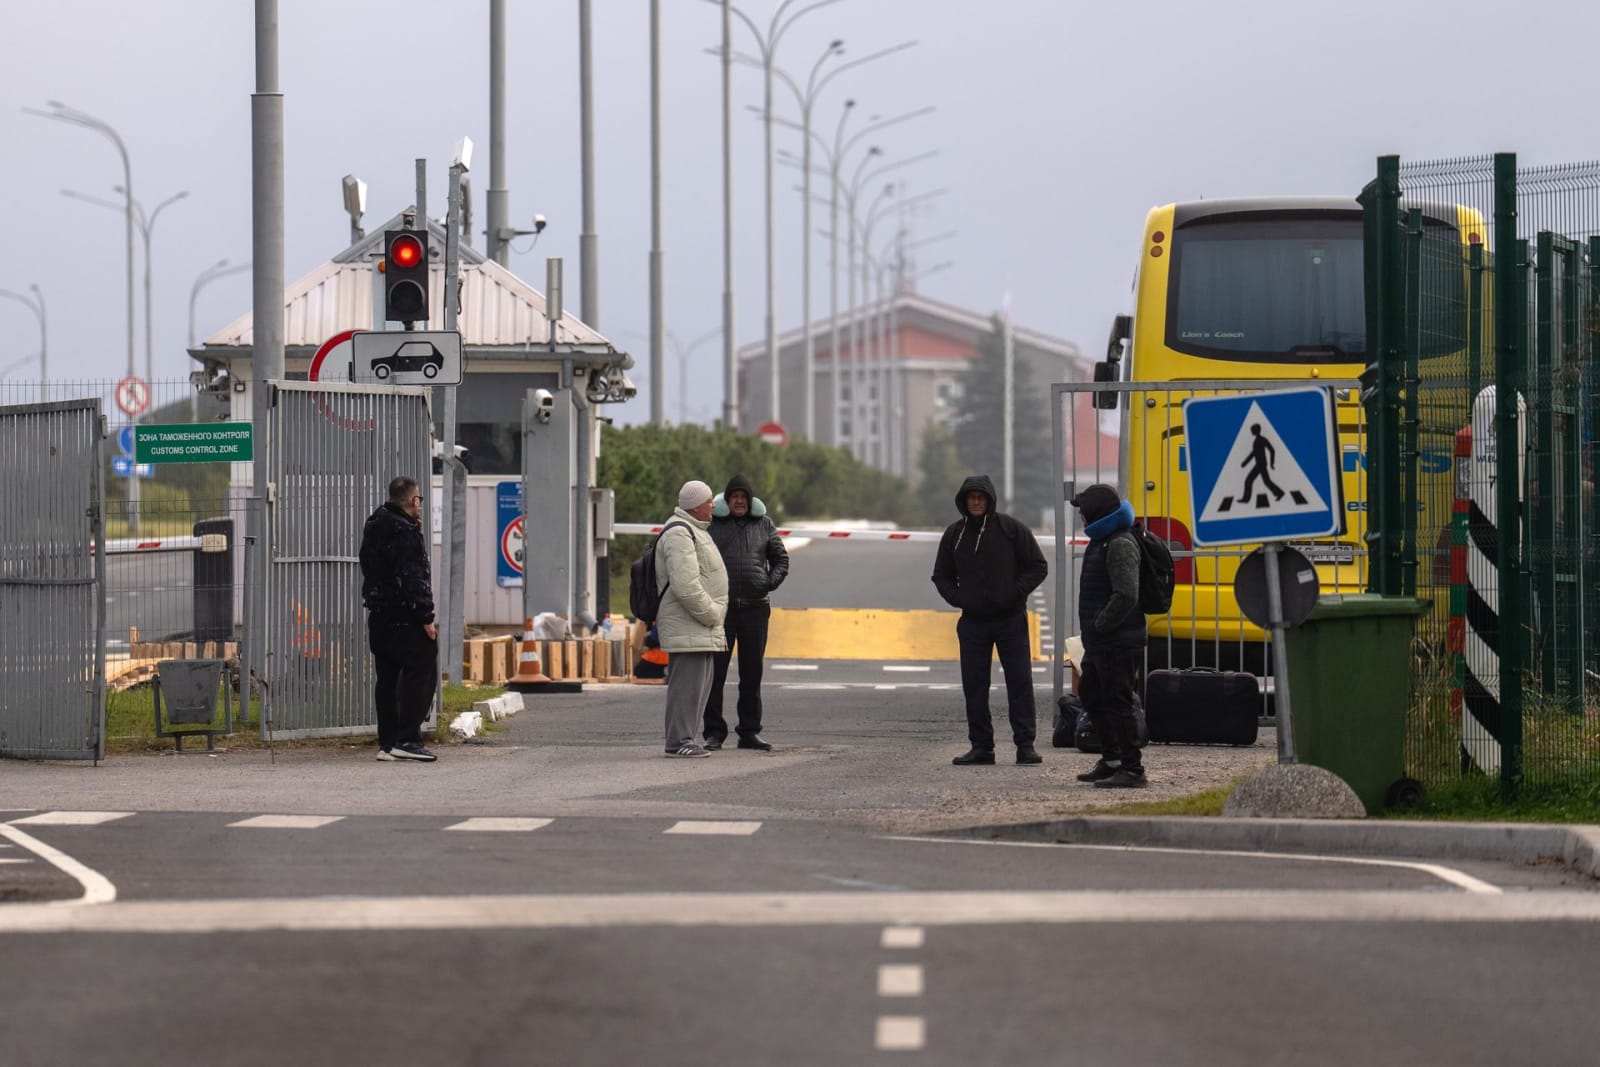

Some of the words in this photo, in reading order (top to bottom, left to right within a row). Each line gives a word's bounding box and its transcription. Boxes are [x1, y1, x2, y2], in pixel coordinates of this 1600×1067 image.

[139, 433, 158, 442] ЗОНА
[159, 432, 213, 441] ТАМОЖЕННОГО
[213, 431, 250, 440] КОНТРОЛЯ
[150, 446, 184, 455] CUSTOMS
[185, 445, 218, 454] CONTROL
[219, 444, 239, 453] ZONE
